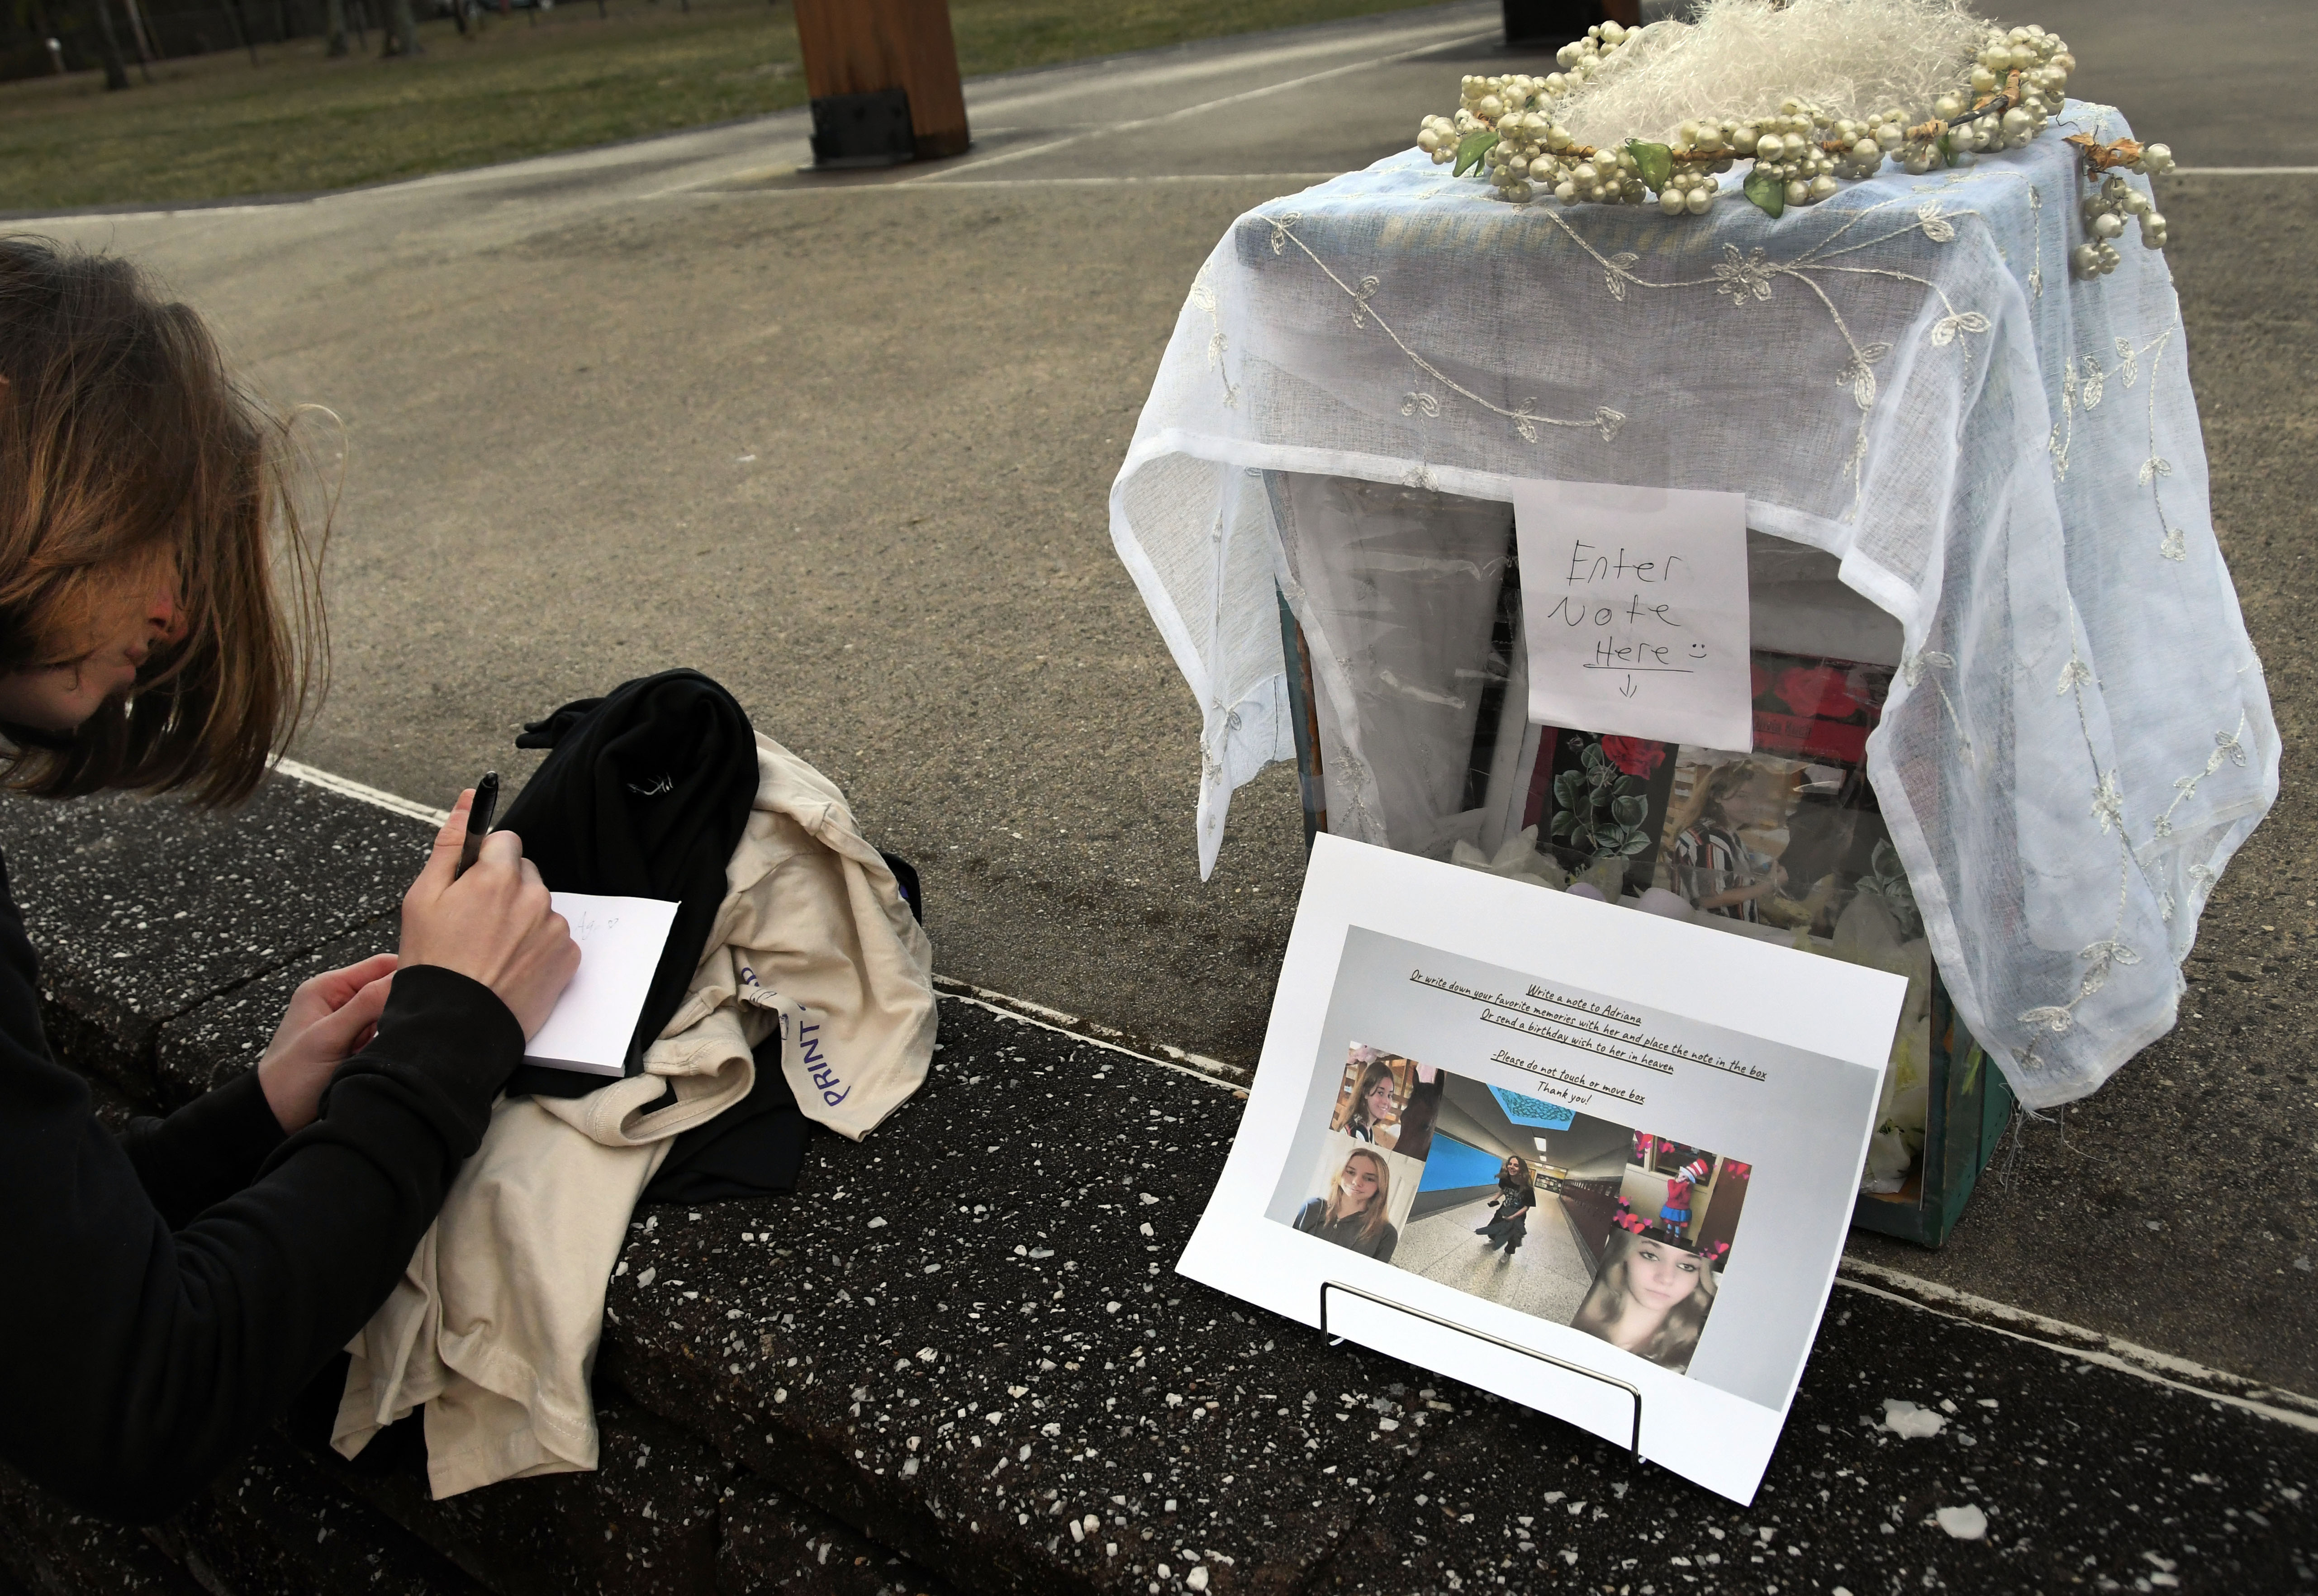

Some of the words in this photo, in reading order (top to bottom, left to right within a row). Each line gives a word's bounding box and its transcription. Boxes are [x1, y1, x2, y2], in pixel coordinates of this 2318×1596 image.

[1566, 539, 1683, 586] Enter
[1547, 594, 1682, 627] Note
[1595, 635, 1670, 667] Here
[1411, 969, 1423, 980] Or
[1425, 977, 1447, 988] write
[1449, 981, 1471, 994] down
[1472, 990, 1493, 1000] your
[1495, 993, 1530, 1012] favorite
[1534, 1007, 1576, 1024] memories
[1579, 1020, 1599, 1031] with
[1603, 1024, 1620, 1036] her
[1623, 1033, 1644, 1043] and
[1643, 1037, 1669, 1050] place
[1672, 1045, 1688, 1056] the
[1692, 1053, 1713, 1064] note
[1716, 1057, 1725, 1067] in
[1729, 1060, 1745, 1073] the
[1750, 1065, 1767, 1079] box
[1528, 984, 1554, 1000] Write
[1567, 998, 1587, 1009] note
[1591, 1003, 1600, 1012] to
[1602, 1005, 1642, 1024] Adriana
[1482, 1008, 1494, 1019] Or
[1496, 1017, 1519, 1027] send
[1528, 1022, 1568, 1044] birthday
[1572, 1038, 1592, 1048] wish
[1596, 1043, 1606, 1052] to
[1609, 1045, 1626, 1057] her
[1629, 1052, 1638, 1062] in
[1641, 1054, 1674, 1072] heaven
[800, 1021, 851, 1107] PRINT
[1493, 1050, 1525, 1066] -Please
[1527, 1060, 1538, 1070] do
[1541, 1067, 1557, 1076] not
[1560, 1069, 1585, 1085] touch
[1602, 1084, 1626, 1096] move
[1629, 1089, 1645, 1103] box
[1538, 1081, 1569, 1099] Thank
[1568, 1095, 1592, 1105] you!
